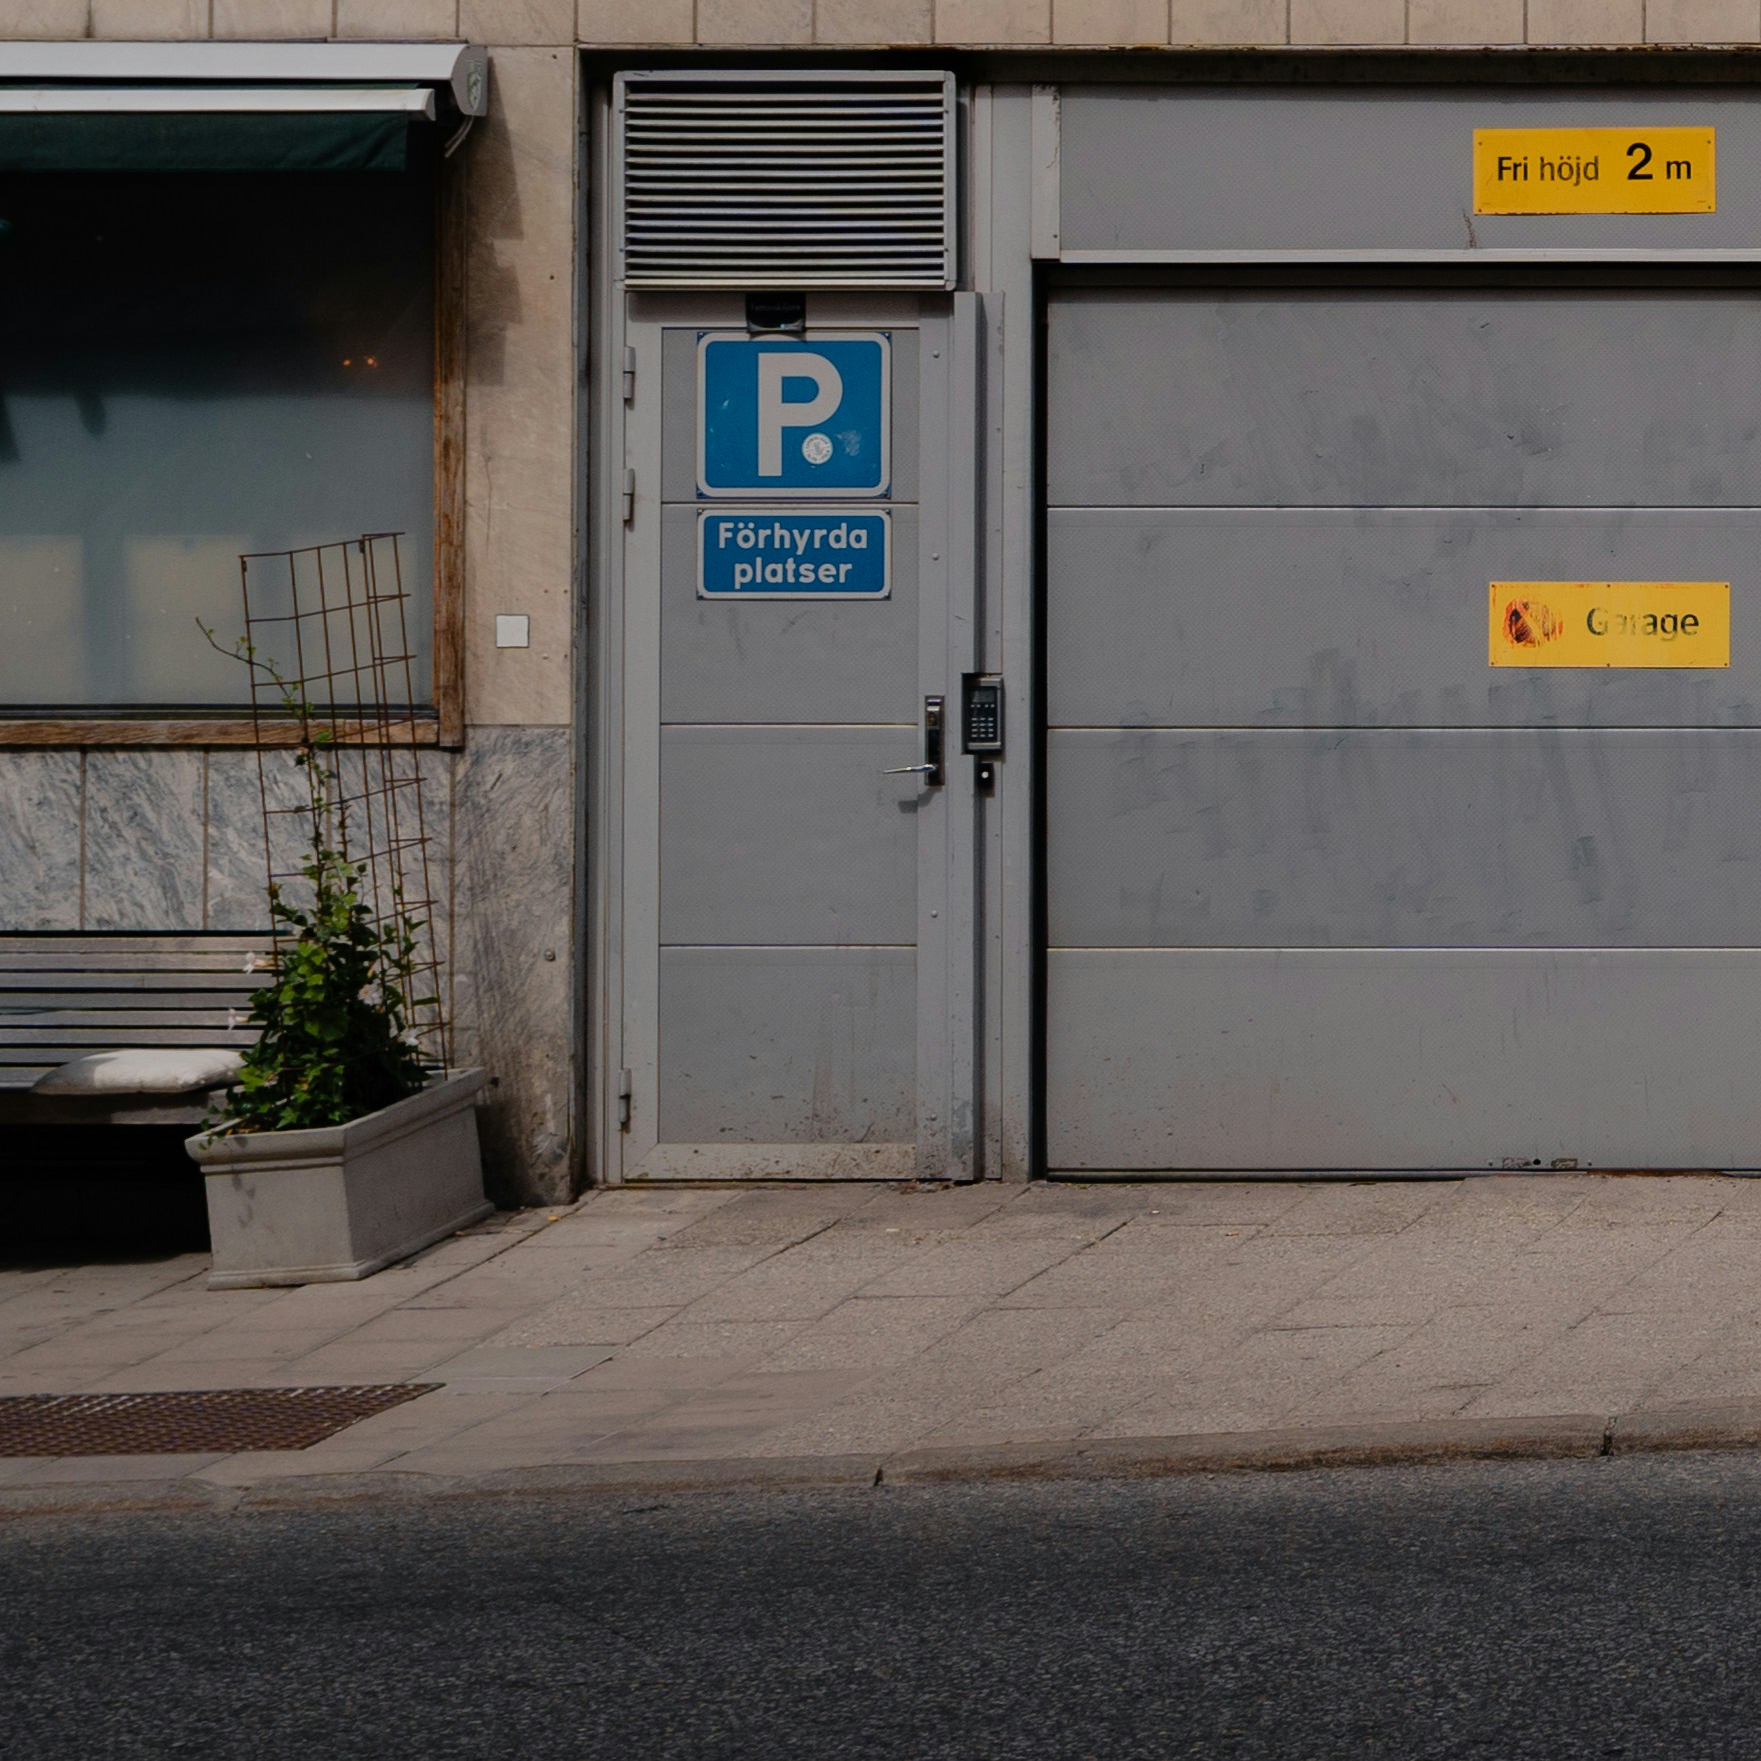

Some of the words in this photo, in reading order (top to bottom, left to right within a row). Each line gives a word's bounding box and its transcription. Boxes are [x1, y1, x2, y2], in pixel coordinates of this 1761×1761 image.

[1497, 156, 1528, 181] Fri
[1539, 154, 1600, 186] höjd
[1626, 142, 1653, 181] 2
[1666, 159, 1692, 181] m
[758, 352, 843, 477] P
[718, 521, 868, 555] Förhyrda
[734, 556, 853, 590] platser
